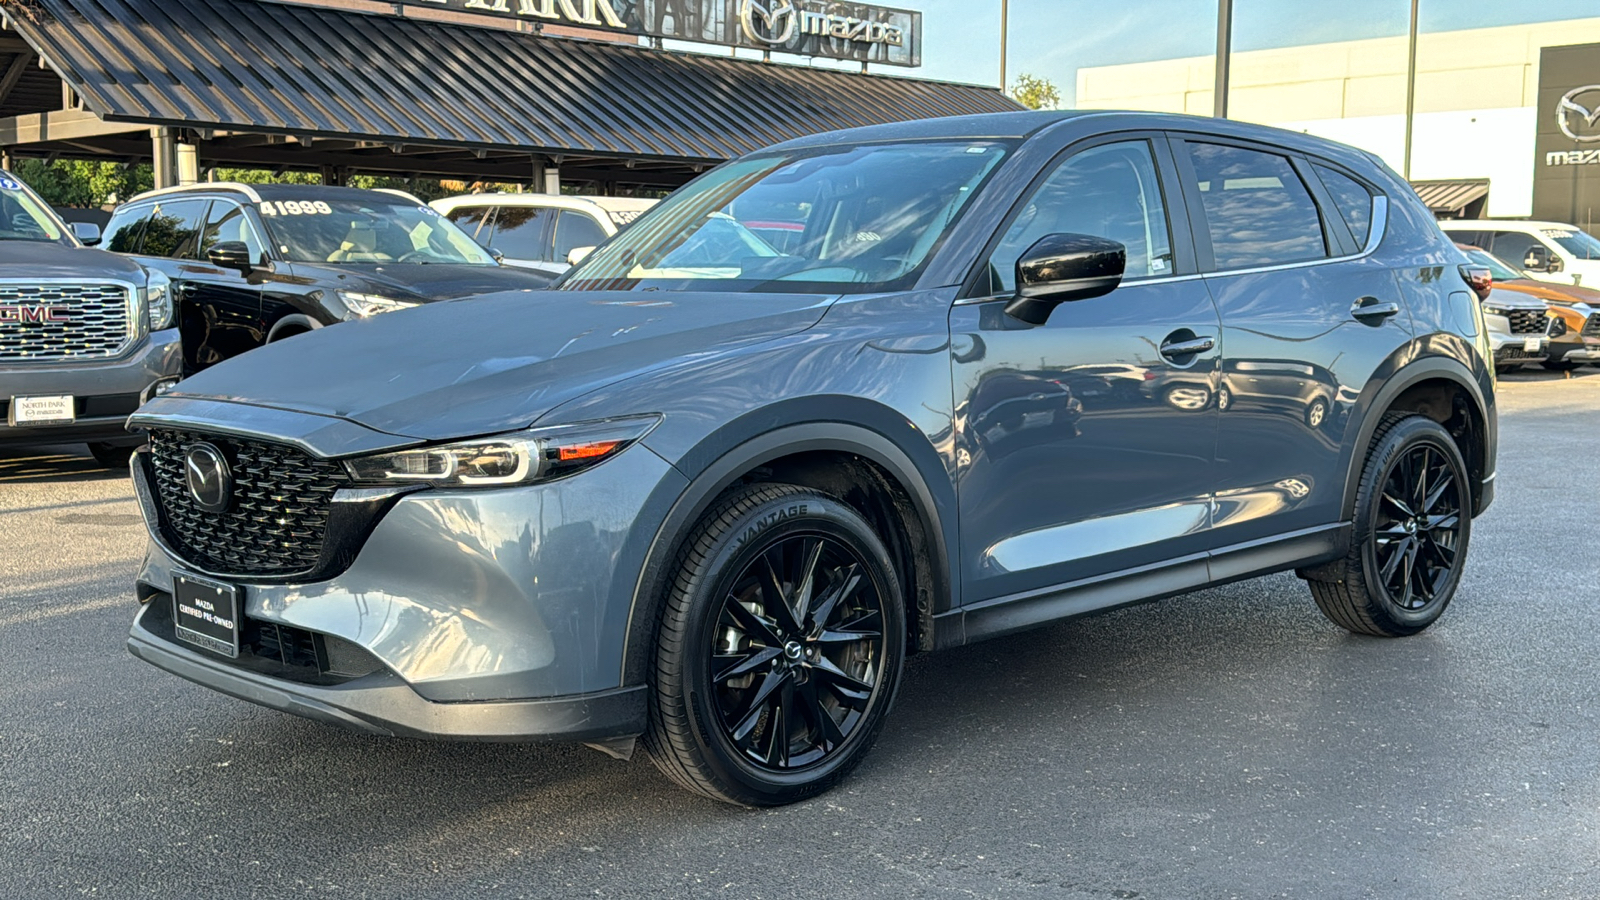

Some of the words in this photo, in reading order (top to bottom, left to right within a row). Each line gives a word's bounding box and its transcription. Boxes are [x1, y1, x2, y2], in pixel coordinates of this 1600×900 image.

[800, 9, 903, 47] mazda
[1546, 150, 1600, 165] maz
[260, 200, 333, 216] 41999
[0, 306, 70, 322] GMC
[22, 401, 47, 409] NORTH
[195, 598, 215, 612] MAZDA
[179, 603, 202, 619] CERTIFIED
[203, 611, 234, 630] PRE-OWNED
